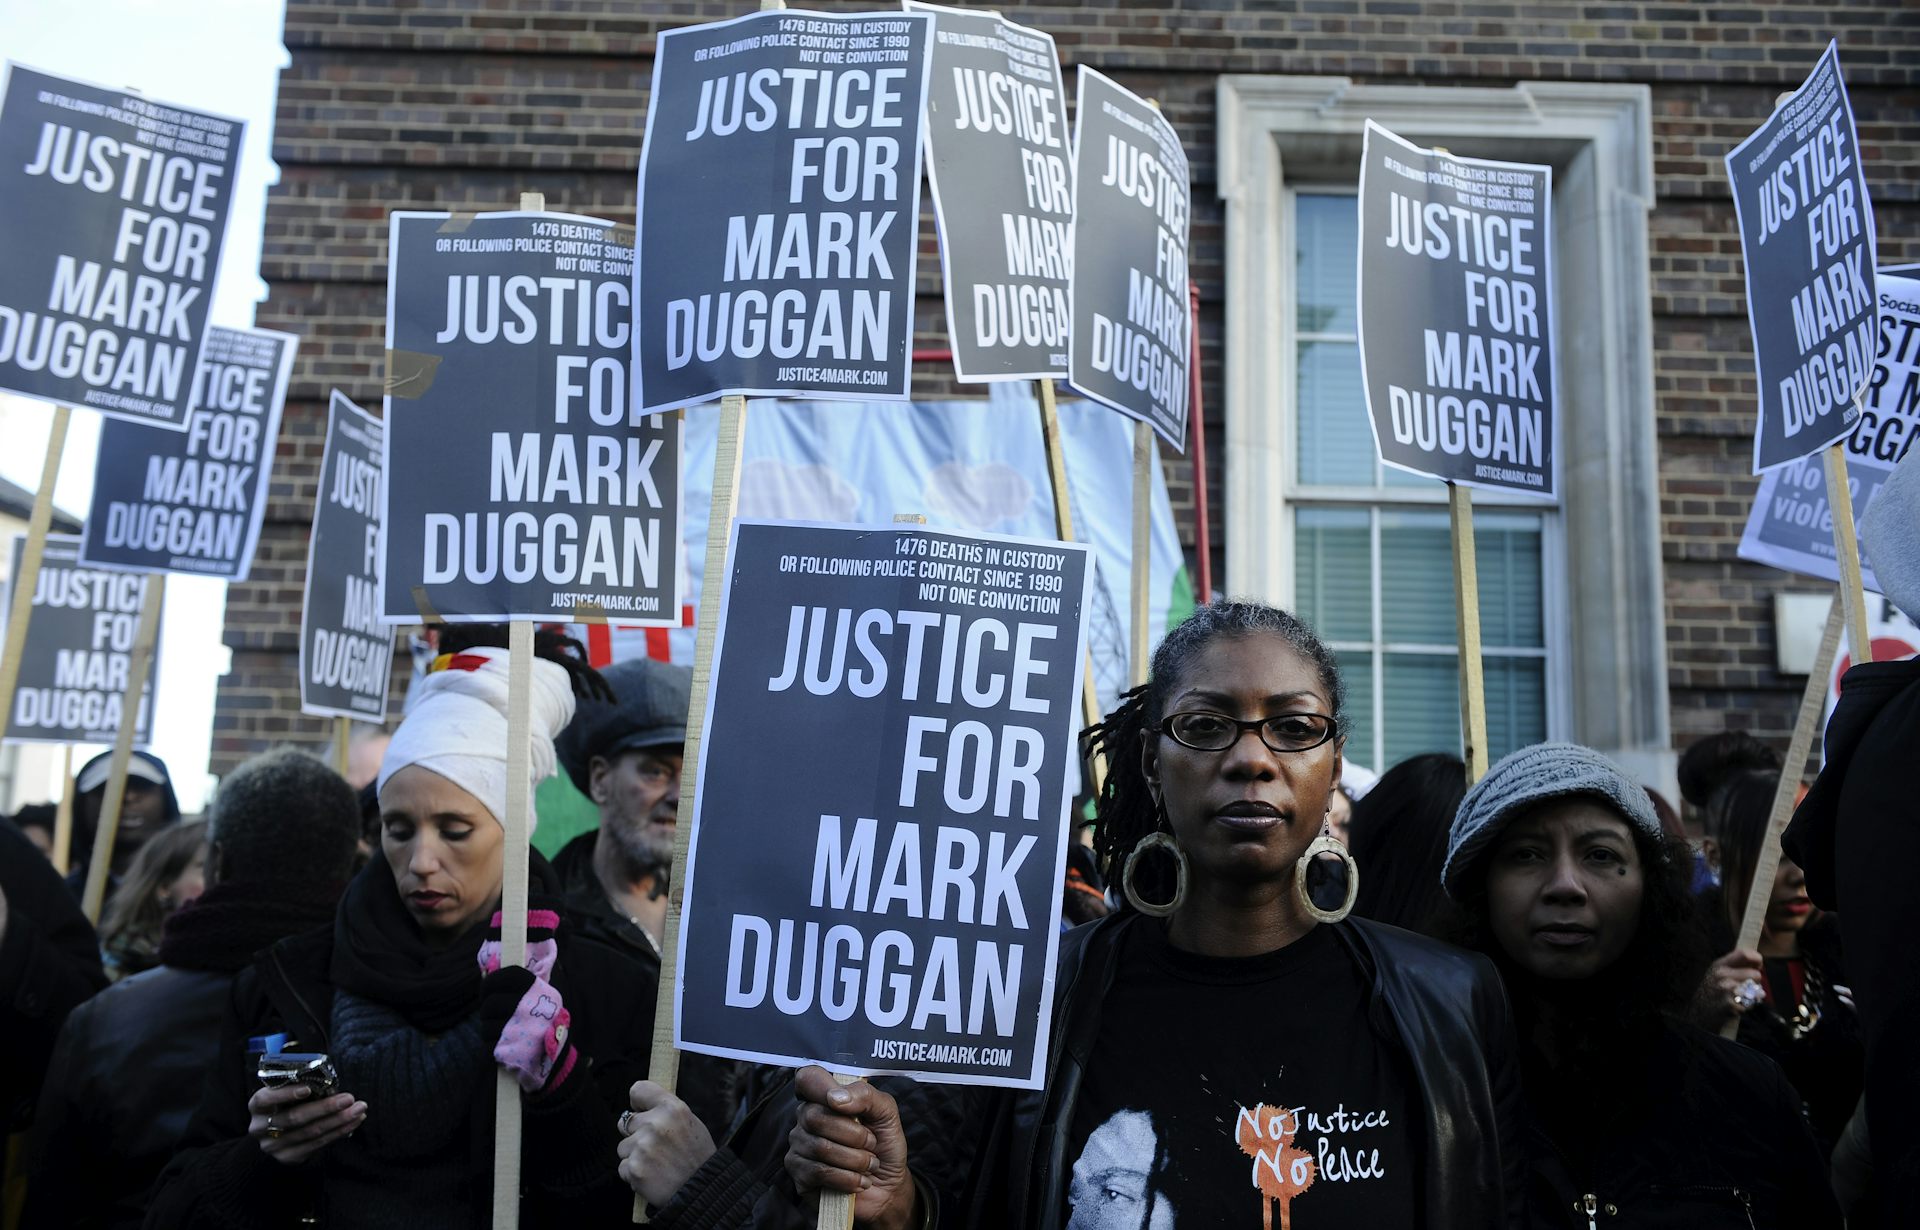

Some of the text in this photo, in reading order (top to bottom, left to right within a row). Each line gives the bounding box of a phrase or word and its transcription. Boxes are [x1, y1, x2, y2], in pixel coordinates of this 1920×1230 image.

[694, 34, 910, 62] OR FOLLOWING POLICE CONTACT SINCE 1990
[778, 19, 911, 35] 1476 DEATHS IN CUSTODY
[799, 50, 909, 63] NOT ONE CONVICTION
[686, 68, 906, 142] JUSTICE
[953, 67, 1061, 149] JUSTICE
[24, 122, 224, 221] JUSTICE
[789, 136, 900, 203] FOR
[1021, 147, 1072, 215] FOR
[1102, 133, 1185, 245] JUSTICE
[1487, 170, 1497, 182] IN
[1498, 172, 1534, 186] CUSTODY
[1487, 185, 1511, 198] SINCE
[1757, 107, 1851, 246] JUSTICE
[113, 207, 211, 281] FOR
[436, 238, 635, 261] OR FOLLOWING POLICE CONTACT SINCE
[532, 222, 560, 237] 1476
[561, 224, 603, 241] DEATHS
[723, 211, 897, 282] MARK
[1386, 192, 1535, 275] JUSTICE
[1807, 178, 1860, 271] FOR
[48, 255, 201, 341] MARK
[556, 257, 578, 271] NOT
[579, 259, 601, 274] ONE
[1156, 224, 1185, 304] FOR
[436, 275, 630, 349] JUSTIC
[667, 289, 890, 371] DUGGAN
[973, 284, 1070, 348] DUGGA
[1127, 267, 1185, 364] MARK
[1465, 270, 1540, 338] FOR
[1791, 243, 1872, 355] MARK
[555, 355, 664, 429] FO
[776, 367, 888, 386] JUSTICE4MARK.COM
[1091, 312, 1184, 421] DUGGAN
[1424, 328, 1543, 403] MARK
[1779, 314, 1875, 439] DUGGAN
[187, 410, 260, 463] FOR
[1389, 385, 1543, 467] DUGGAN
[143, 455, 253, 512] MARK
[330, 450, 381, 521] JUSTI
[490, 432, 664, 508] MARK
[1475, 464, 1544, 486] JUSTICE4MARK.COM
[1783, 464, 1822, 491] No
[105, 501, 244, 560] DUGGAN
[423, 512, 660, 589] DUGGAN
[895, 538, 1065, 572] 1476 DEATHS IN CUSTODY
[551, 592, 660, 612] JUSTICE4MARK.COM
[780, 555, 1062, 593] OR FOLLOWING POLICE CONTACT SINCE 1990
[919, 583, 1060, 614] NOT ONE CONVICTION
[92, 611, 141, 652] FO
[768, 605, 1058, 714] JUSTICE
[55, 649, 150, 692] MAR
[899, 715, 1045, 821] FOR
[810, 814, 1039, 930] MARK
[724, 913, 1025, 1038] DUGGAN
[871, 1039, 1012, 1068] JUSTICE4MARK.COM
[1235, 1102, 1389, 1144] No Justice
[1252, 1137, 1384, 1189] No Peace
